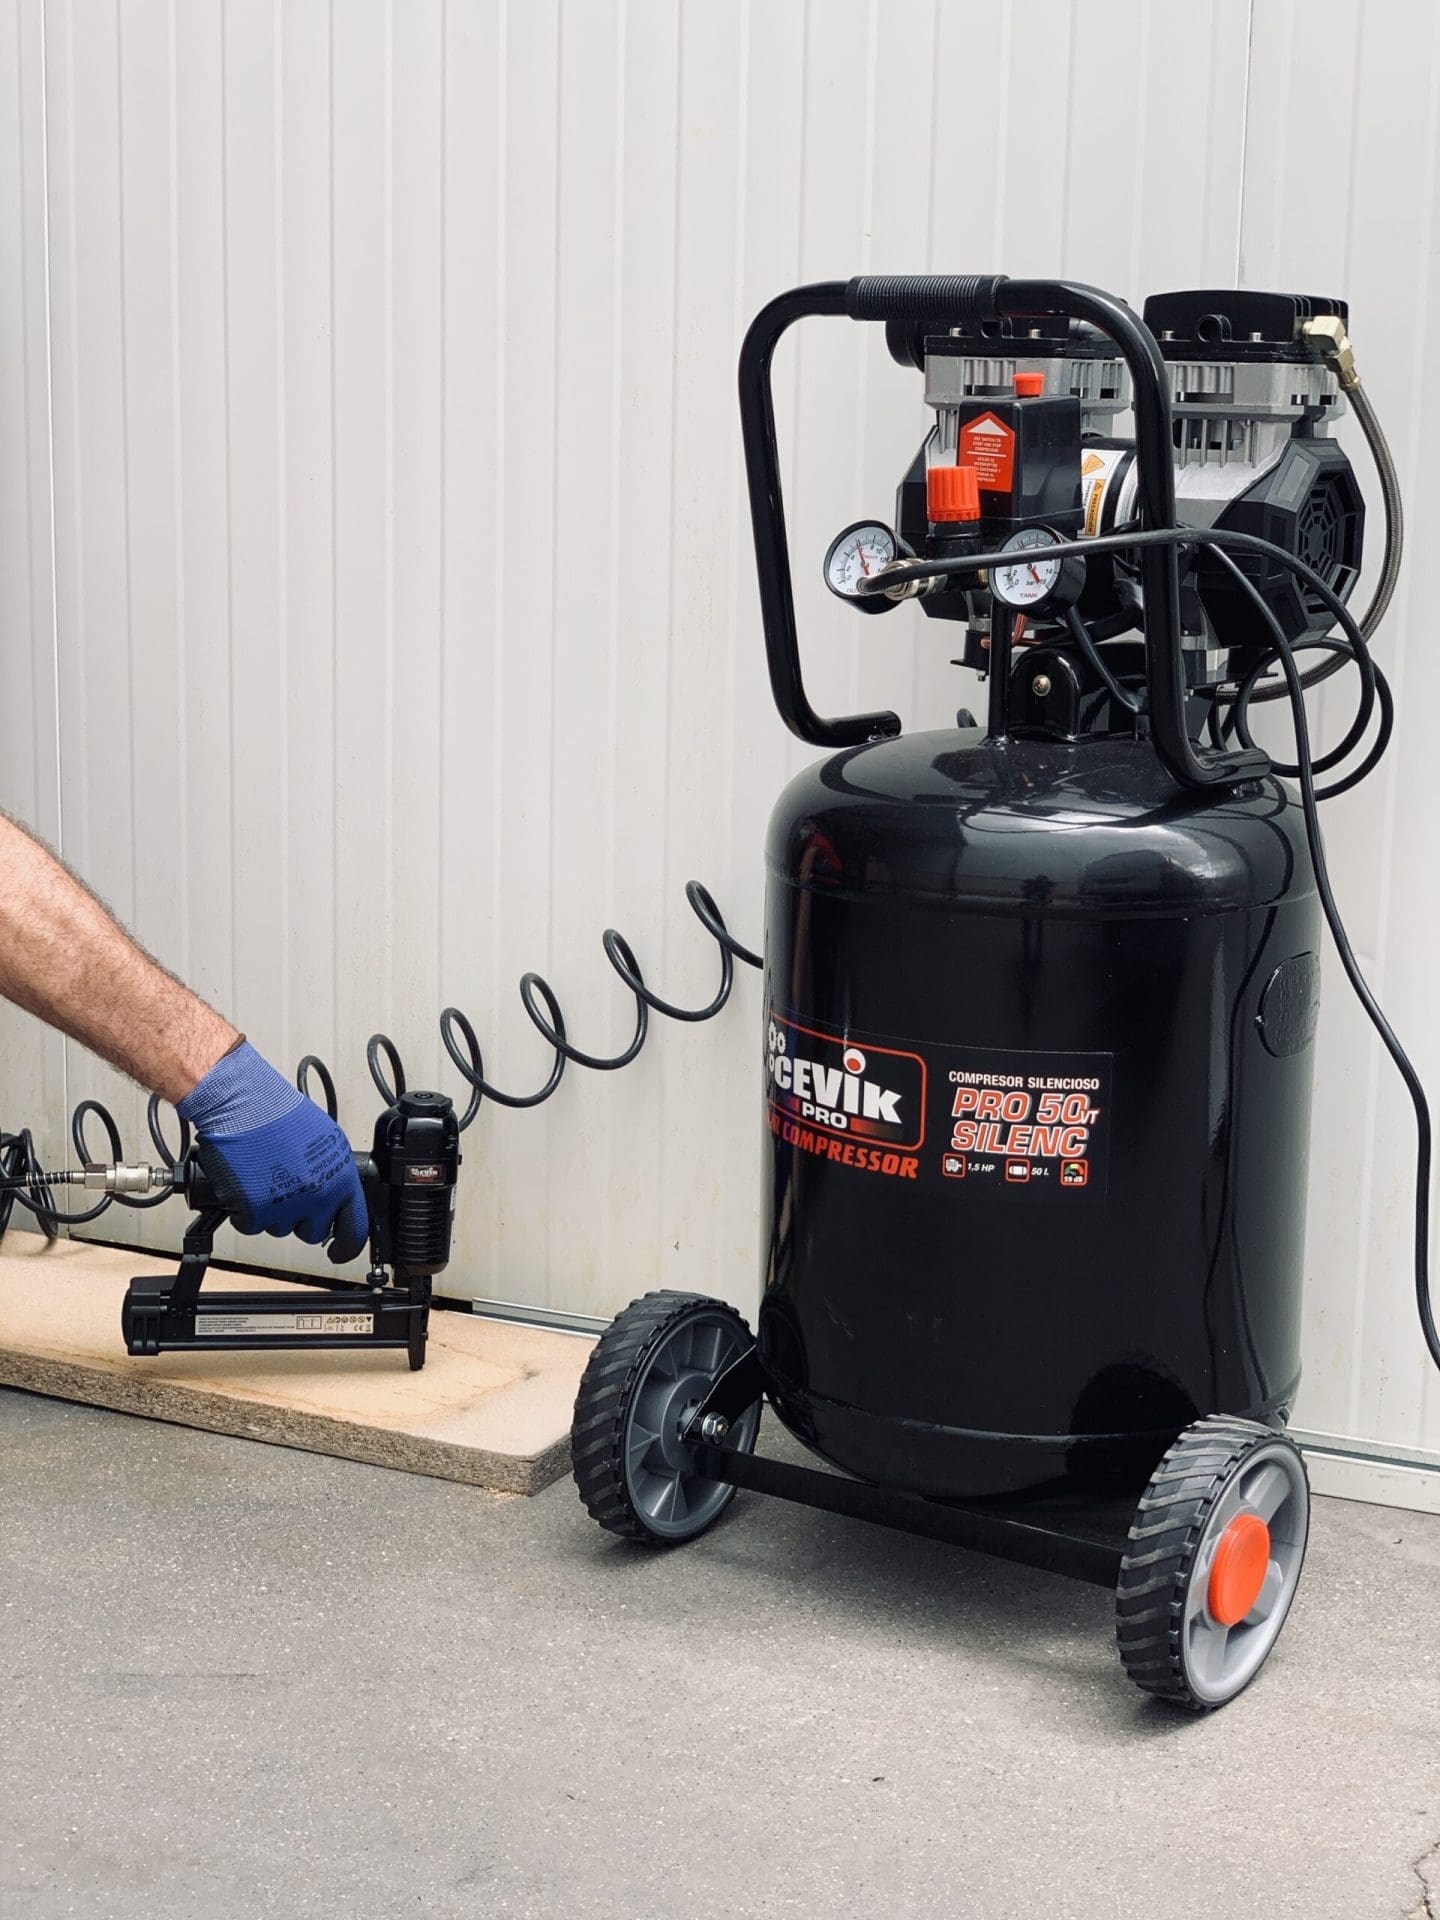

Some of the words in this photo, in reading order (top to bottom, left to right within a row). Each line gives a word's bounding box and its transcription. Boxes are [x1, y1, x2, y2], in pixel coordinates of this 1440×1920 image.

[948, 1071, 1024, 1088] COMPRESOR
[1027, 1077, 1100, 1090] SILENCIOSO
[802, 1101, 848, 1129] PRO
[951, 1087, 1031, 1122] PRO
[782, 1120, 919, 1178] COMPRESSOR
[951, 1120, 1090, 1158] SILENC
[967, 1162, 980, 1173] 1,5
[981, 1164, 995, 1173] HP
[1031, 1167, 1043, 1176] 50
